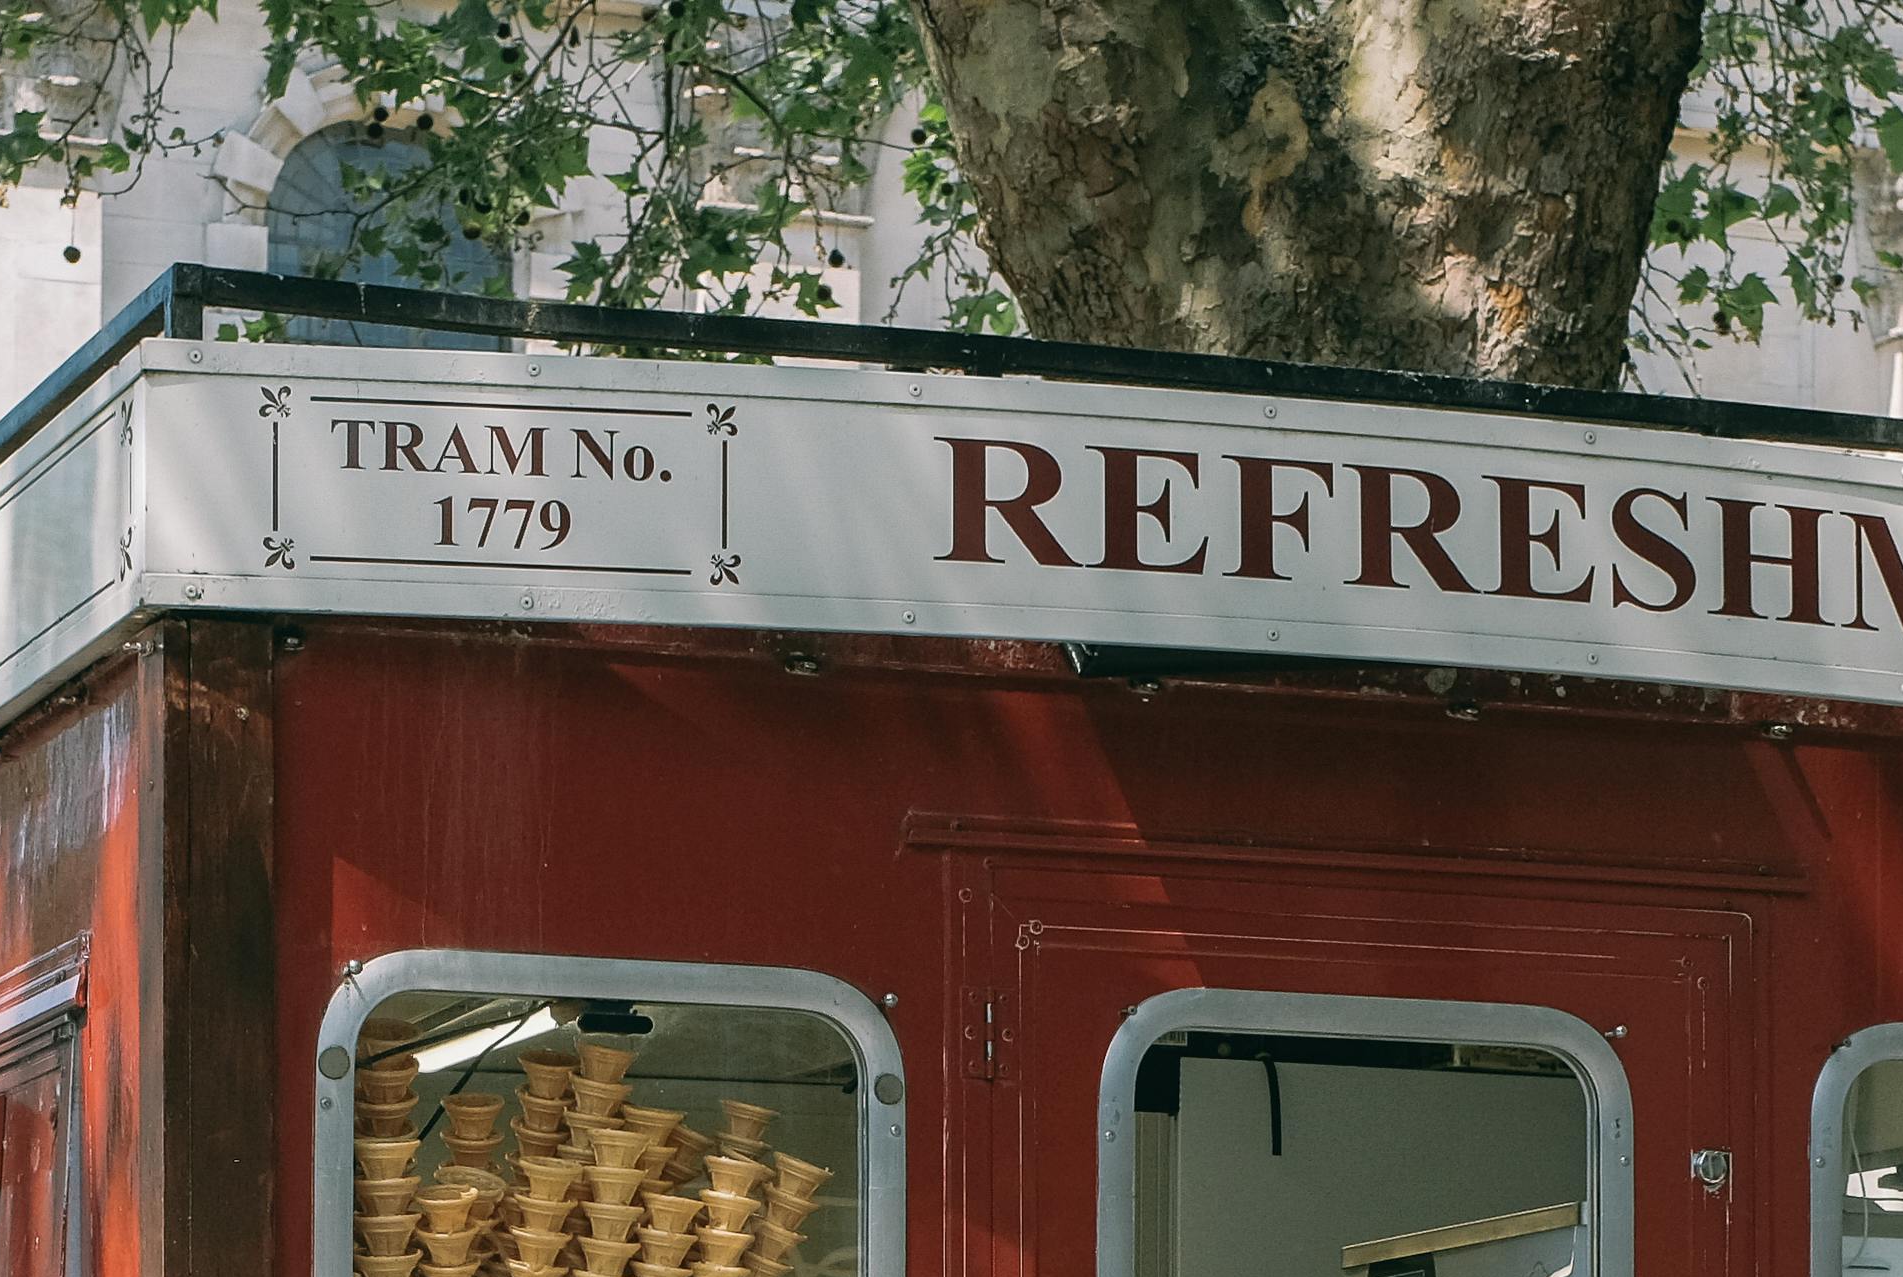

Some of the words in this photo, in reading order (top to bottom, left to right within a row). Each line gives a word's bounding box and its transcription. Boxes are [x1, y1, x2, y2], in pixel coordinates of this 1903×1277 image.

[330, 416, 552, 484] TRAM
[572, 426, 672, 486] No.
[430, 495, 575, 553] 1779
